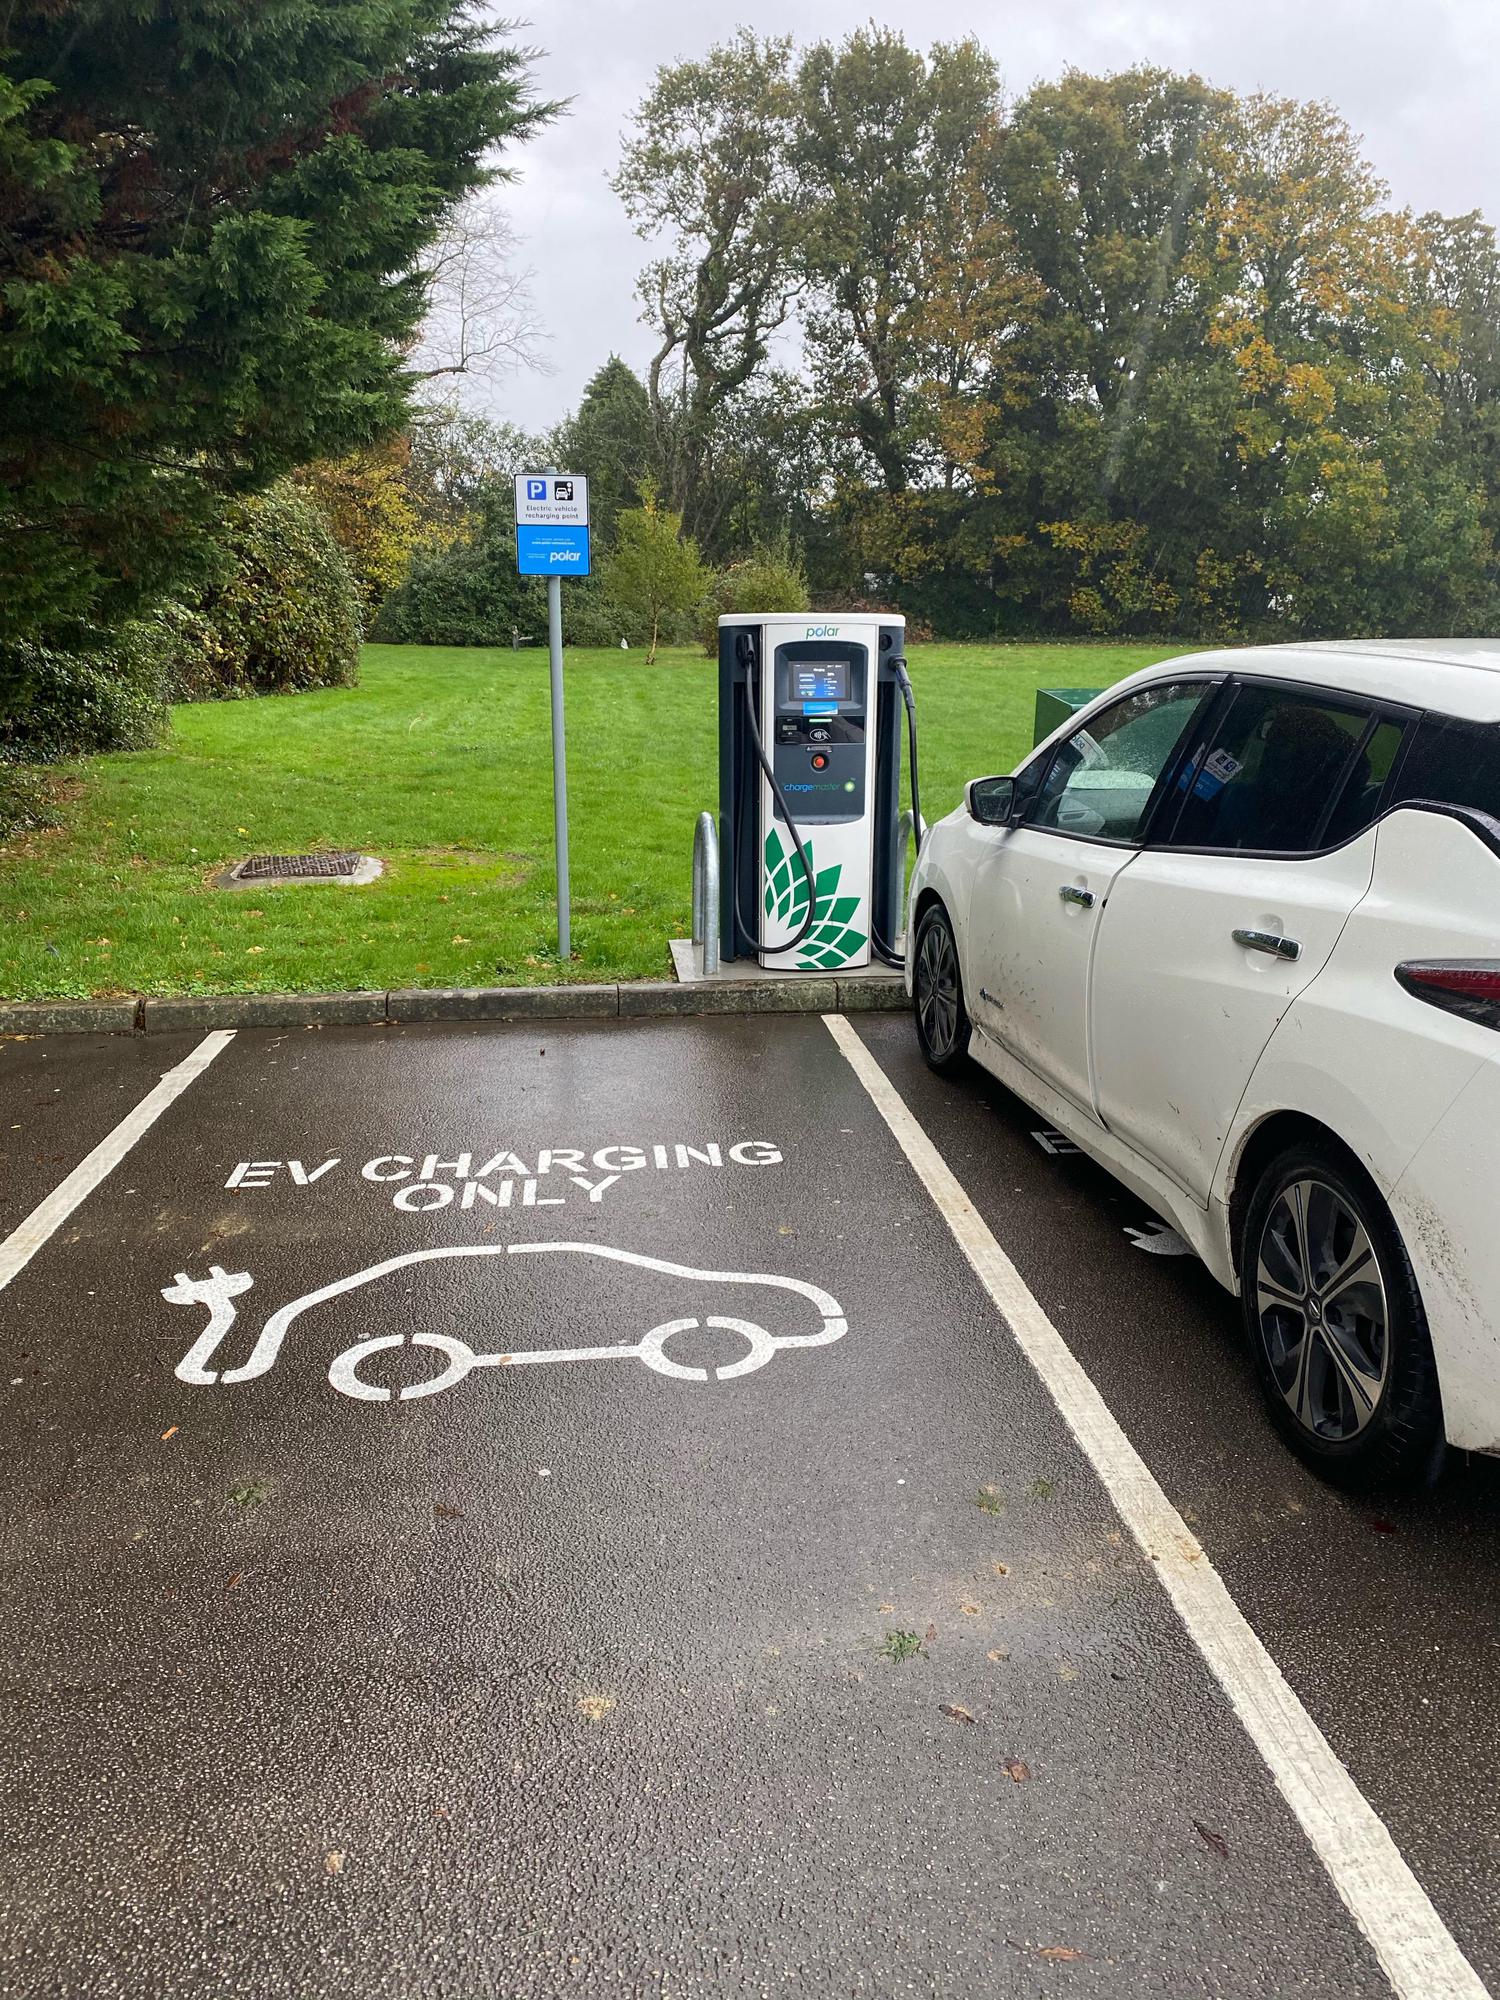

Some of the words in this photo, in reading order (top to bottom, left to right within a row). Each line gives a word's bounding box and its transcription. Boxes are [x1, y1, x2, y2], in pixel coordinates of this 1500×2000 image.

[530, 482, 543, 498] P
[525, 512, 560, 520] recharging
[549, 549, 581, 564] polar
[805, 624, 841, 640] polar
[783, 783, 840, 793] chargemaster
[224, 1158, 341, 1188] EV
[361, 1141, 784, 1182] CHARGING
[392, 1175, 622, 1212] ONLY
